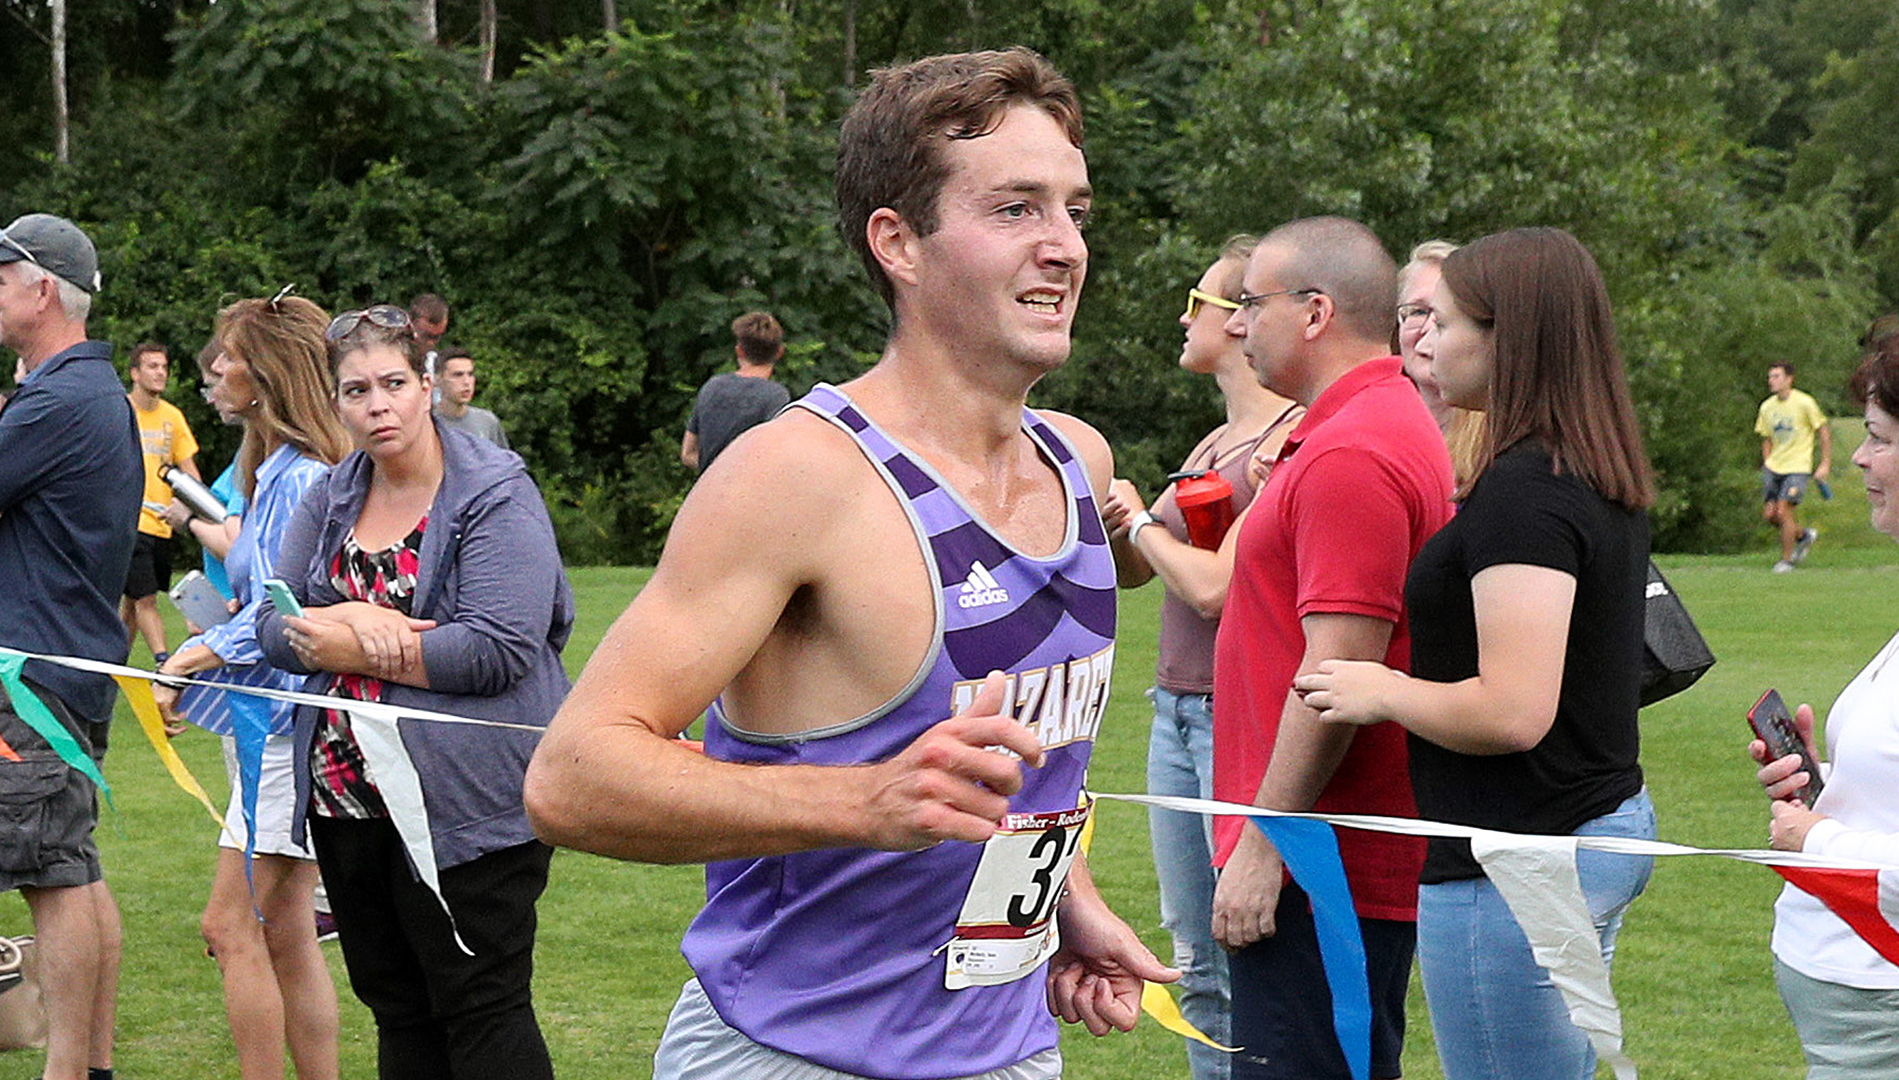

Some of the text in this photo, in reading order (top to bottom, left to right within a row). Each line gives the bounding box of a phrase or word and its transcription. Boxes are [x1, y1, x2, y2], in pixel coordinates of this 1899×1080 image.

[958, 588, 1010, 608] adidas
[1006, 814, 1049, 829] Fisher
[1007, 823, 1083, 928] 3
